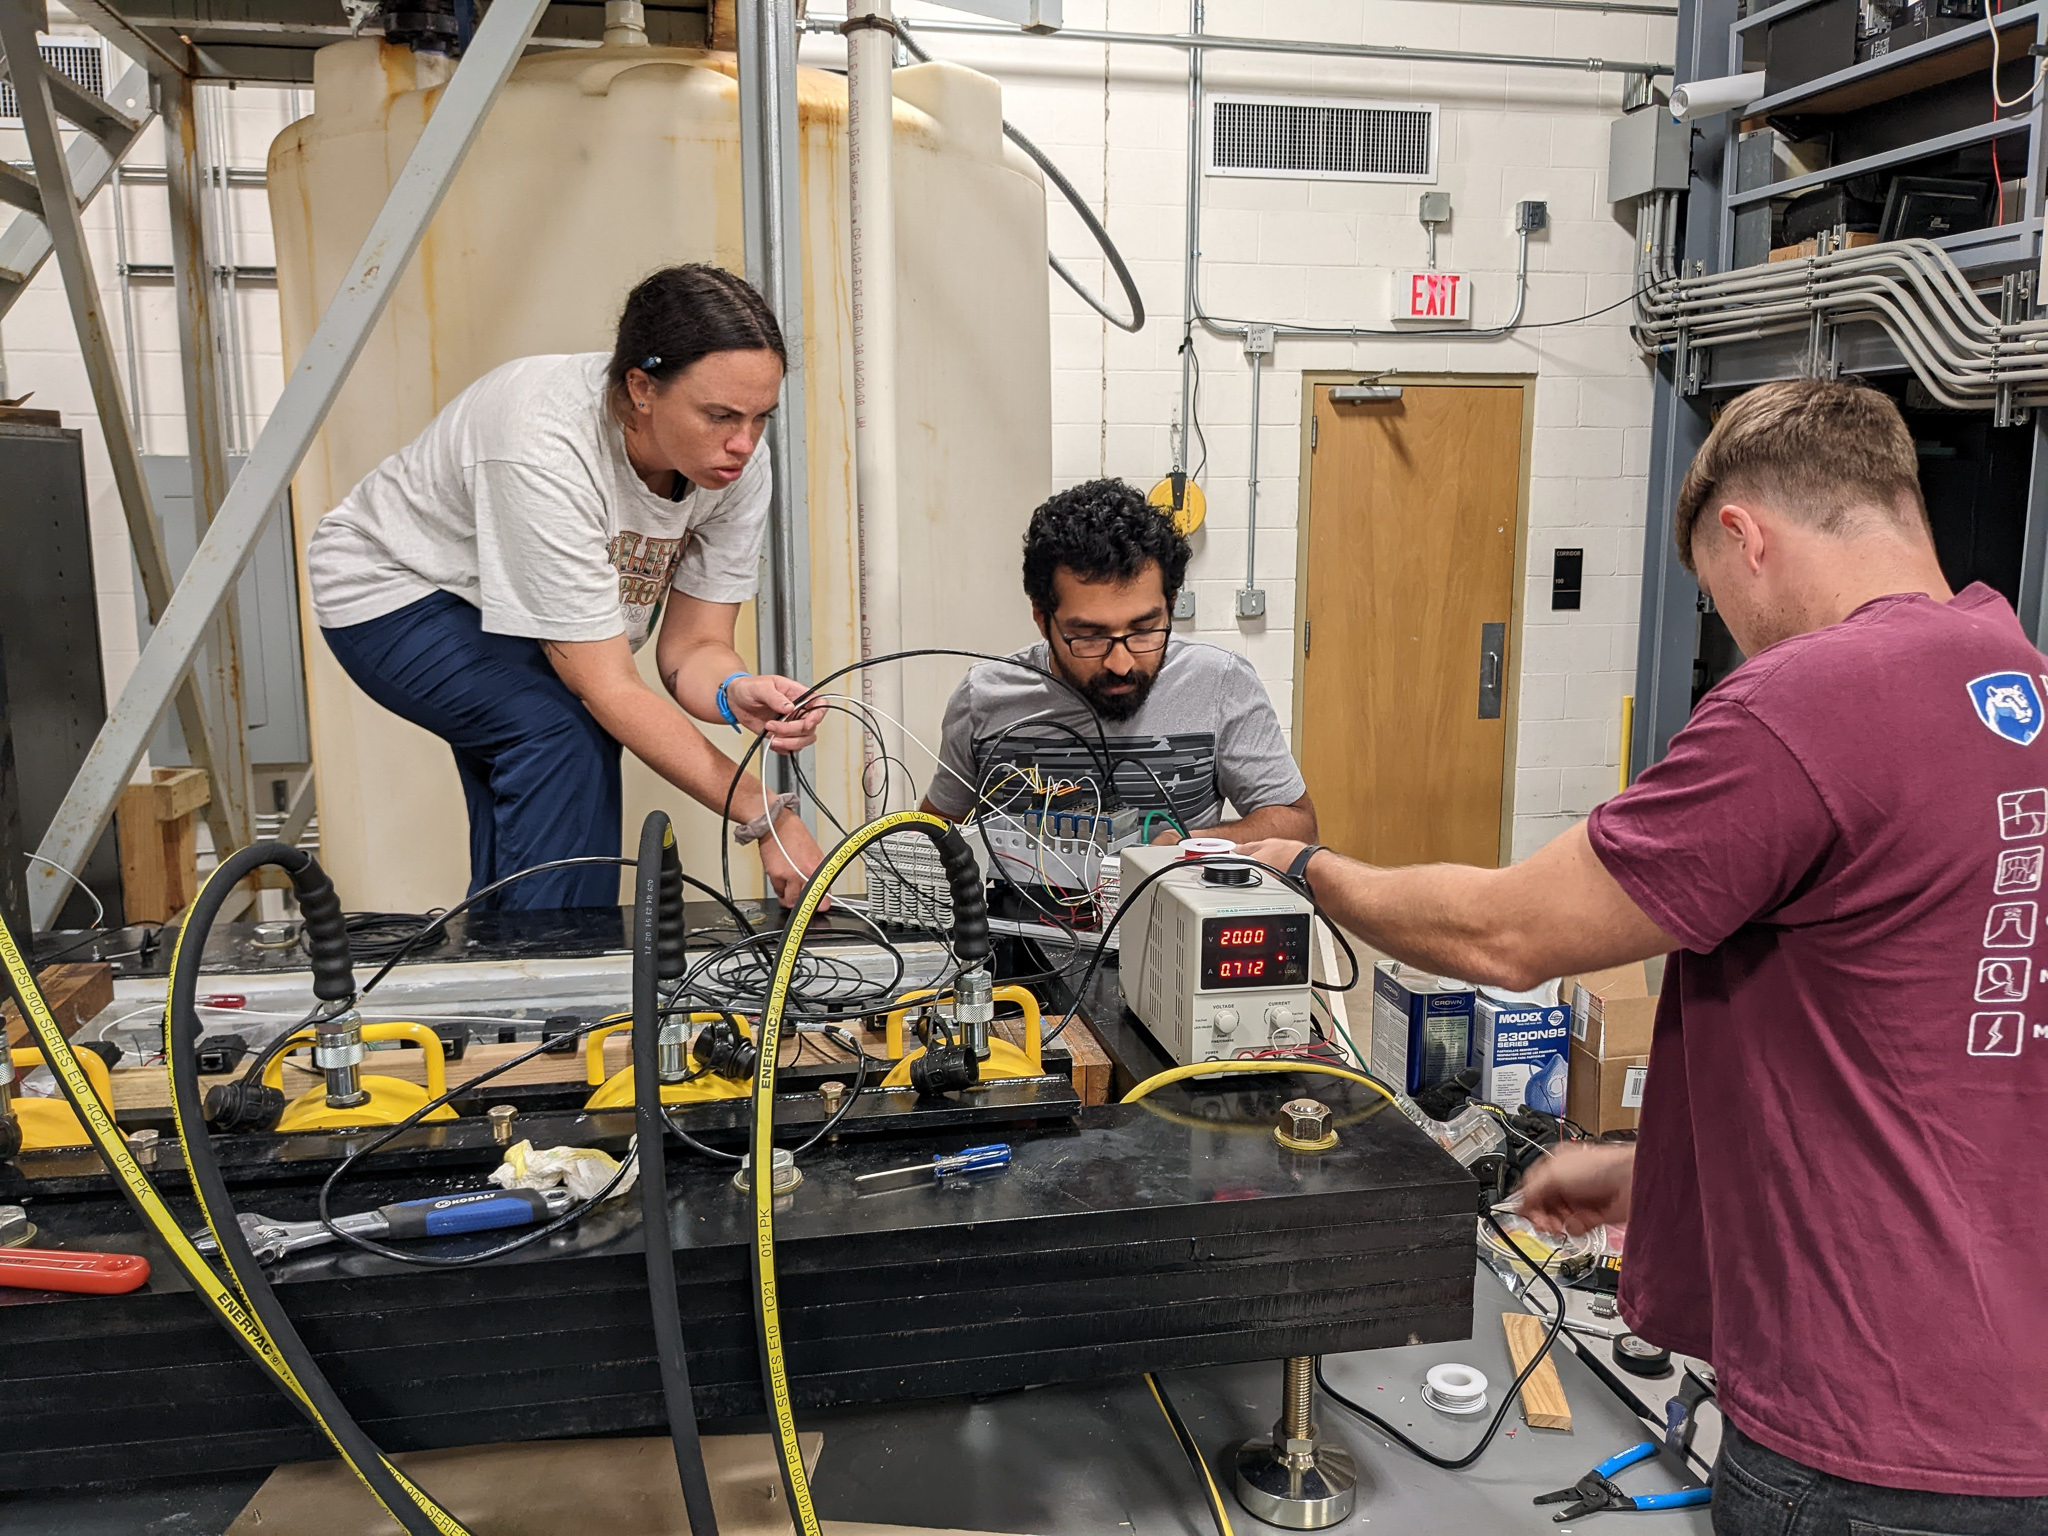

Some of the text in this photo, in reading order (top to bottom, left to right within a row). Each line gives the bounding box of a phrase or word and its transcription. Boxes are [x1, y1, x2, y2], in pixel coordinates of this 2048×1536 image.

[1411, 275, 1460, 316] EXIT
[862, 626, 873, 718] CHALOTTE
[761, 1017, 778, 1089] ENERPAC
[780, 948, 795, 970] 700
[821, 863, 838, 882] PSI
[835, 845, 853, 864] 900
[851, 820, 885, 847] SERIES
[885, 814, 903, 825] E10
[908, 812, 930, 821] 1Q21
[1383, 982, 1398, 997] CROWN
[1499, 1012, 1542, 1024] MOLDEX
[1497, 1027, 1566, 1042] 2300N95
[14, 967, 32, 989] PSI
[25, 991, 45, 1015] 900
[40, 1017, 73, 1068] SERIES
[67, 1069, 88, 1095] E10
[85, 1102, 112, 1136] 4Q21
[116, 1152, 138, 1177] 012
[132, 1177, 152, 1199] PK
[217, 1291, 273, 1355] ENERPAC
[452, 1193, 496, 1205] KOBALT
[760, 1208, 770, 1228] PK
[760, 1233, 772, 1257] 012
[763, 1280, 776, 1313] 1Q21
[767, 1325, 780, 1351] E10
[771, 1355, 788, 1407] SERIES
[780, 1411, 794, 1437] 900
[785, 1440, 799, 1465] PSI
